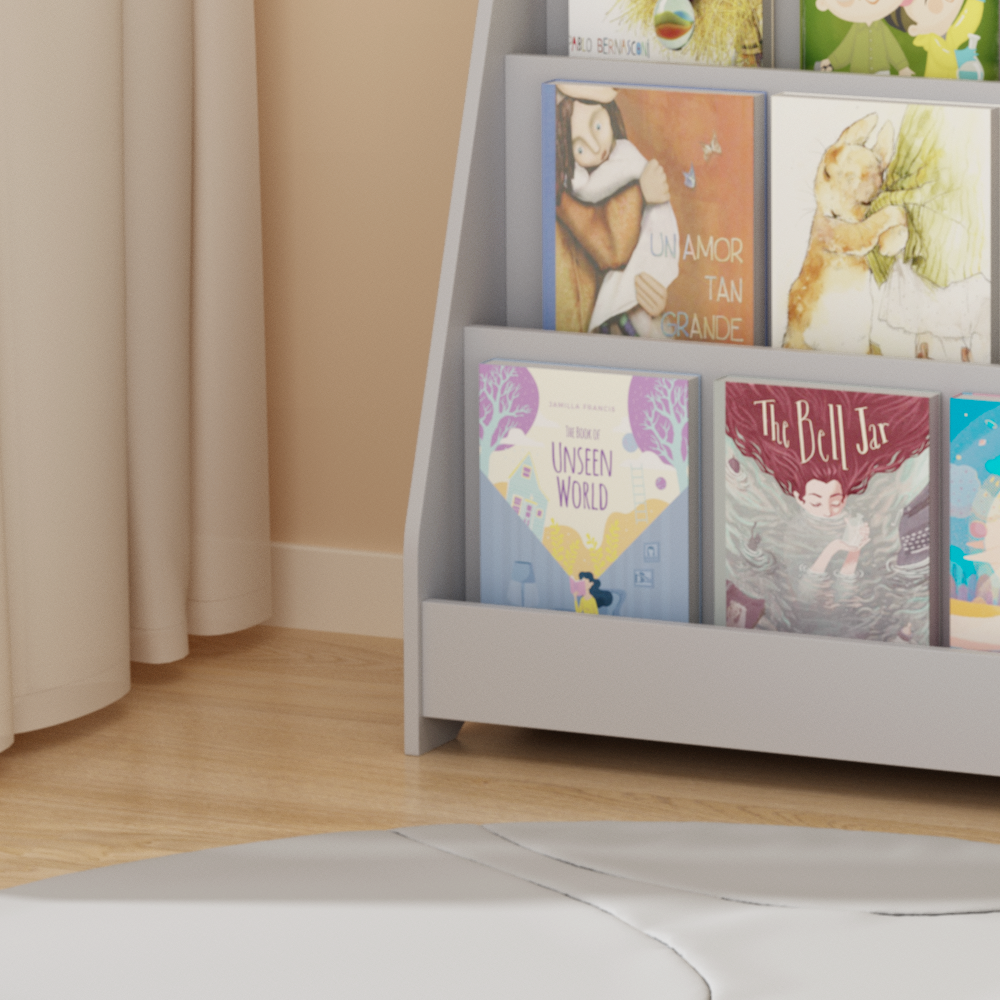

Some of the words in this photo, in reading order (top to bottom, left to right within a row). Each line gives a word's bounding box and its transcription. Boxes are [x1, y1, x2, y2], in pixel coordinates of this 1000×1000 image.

[650, 232, 677, 259] UN
[682, 233, 744, 264] AMOR
[704, 275, 743, 304] TAN
[660, 311, 745, 342] GRANDE
[582, 402, 616, 412] FRANCIS
[565, 424, 575, 438] THE
[576, 425, 592, 439] BOOK
[593, 428, 601, 440] OF
[753, 399, 790, 449] The
[795, 399, 849, 471] Bell
[854, 406, 890, 455] Jar
[551, 441, 613, 477] UNSEEN
[556, 475, 608, 511] WORLD
